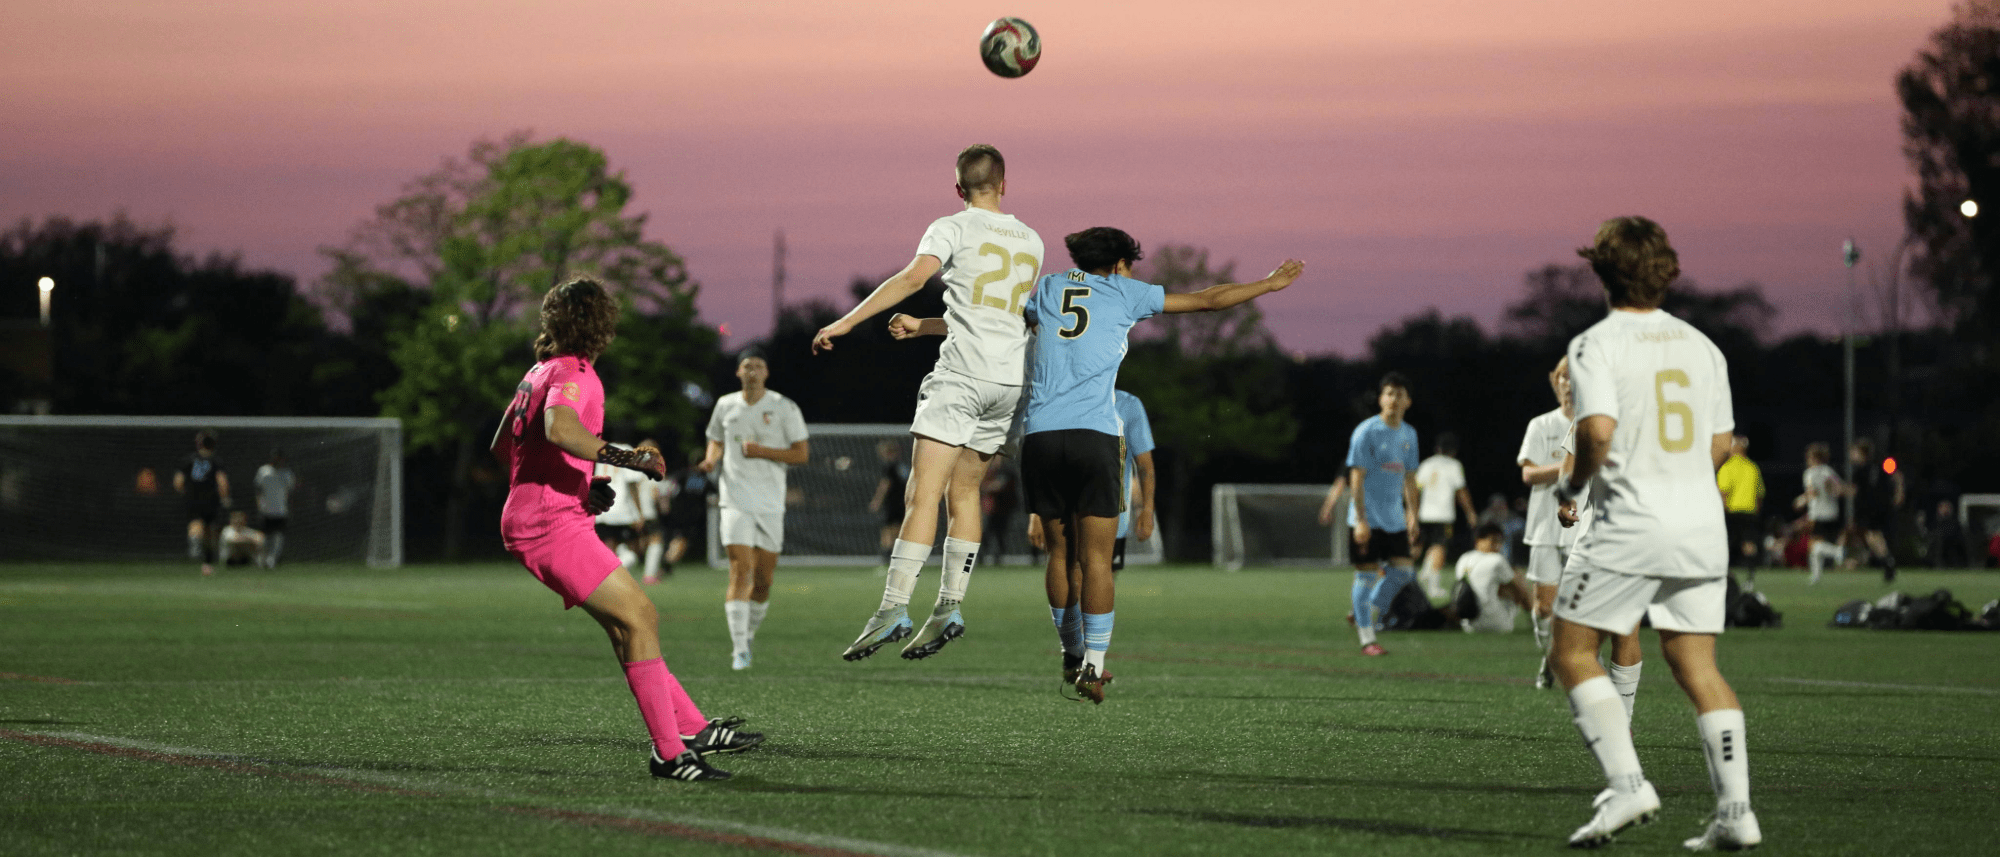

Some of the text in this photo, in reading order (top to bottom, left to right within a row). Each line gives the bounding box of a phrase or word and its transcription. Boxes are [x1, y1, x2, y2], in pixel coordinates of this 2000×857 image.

[972, 241, 1038, 317] 22
[1057, 287, 1091, 340] 5
[1655, 368, 1695, 453] 6
